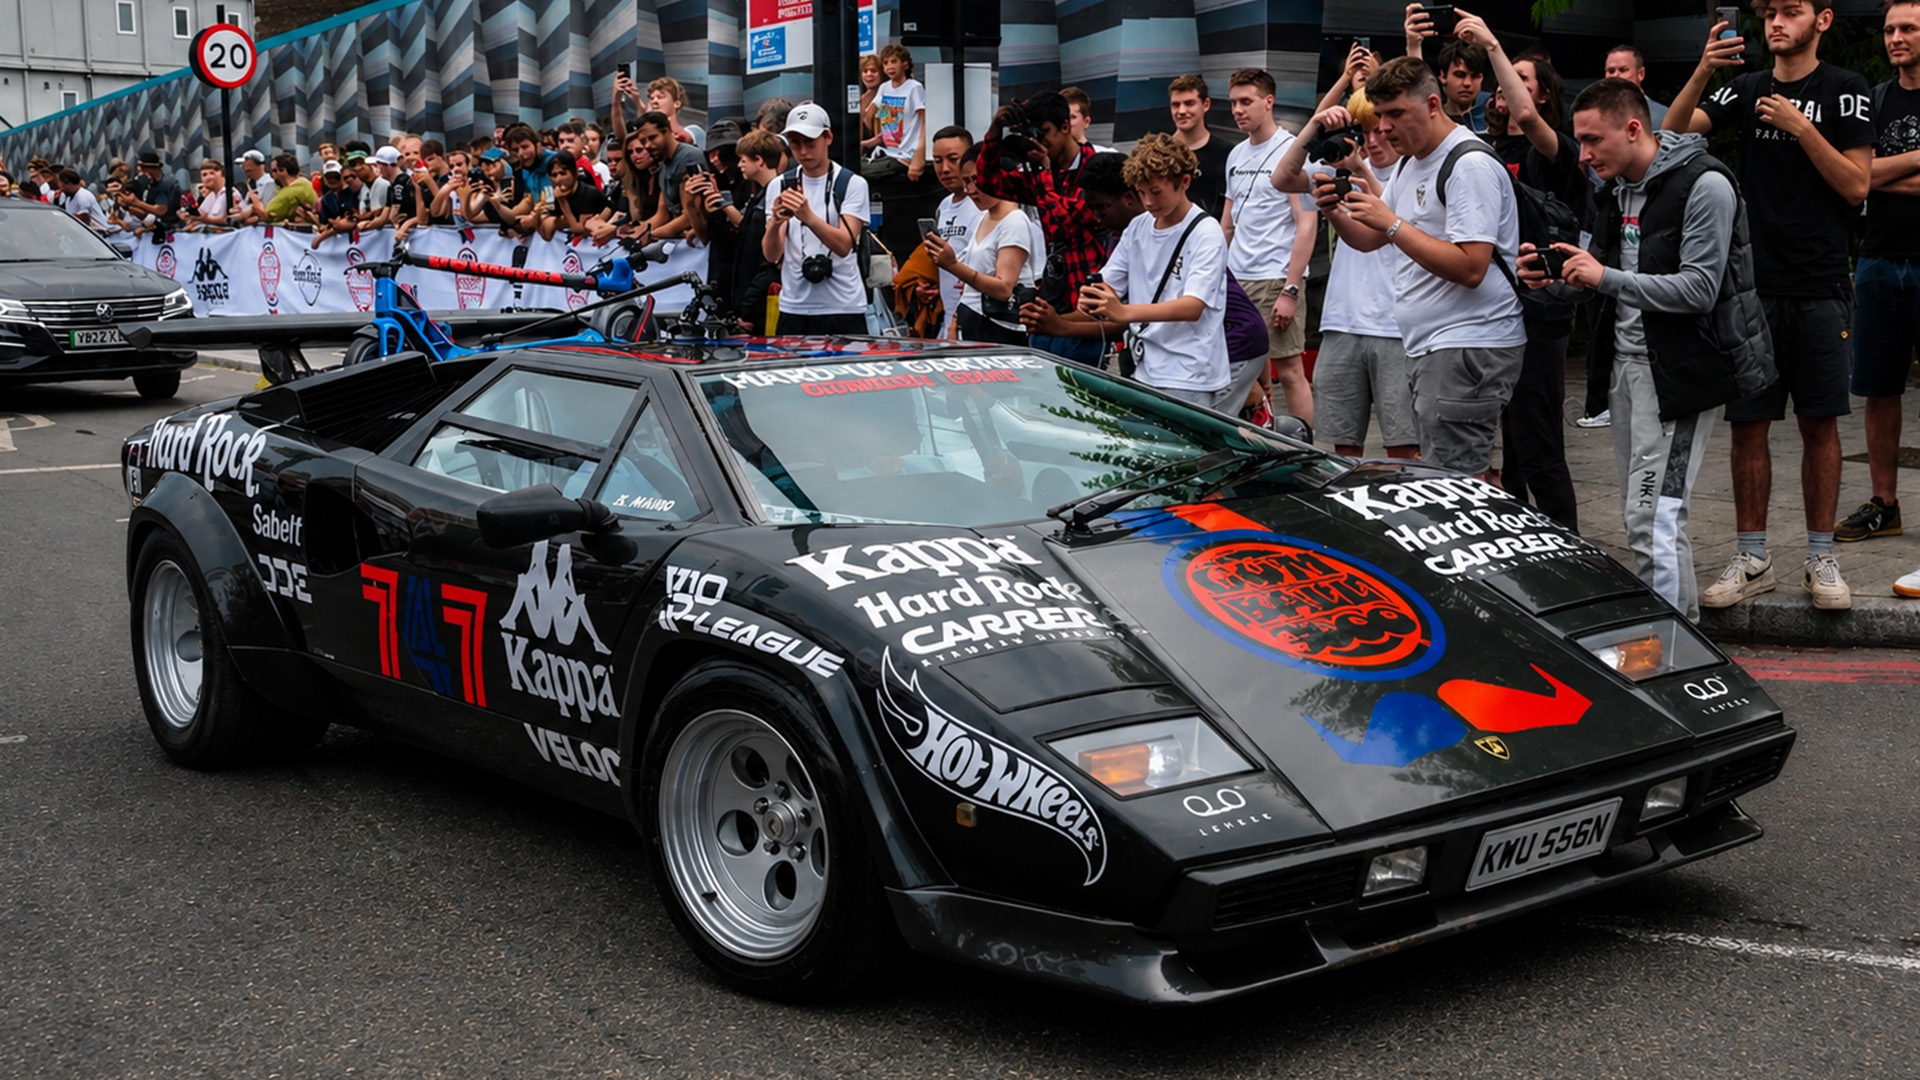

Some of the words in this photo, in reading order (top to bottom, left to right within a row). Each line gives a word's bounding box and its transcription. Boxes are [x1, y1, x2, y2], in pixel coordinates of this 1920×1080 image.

[209, 42, 248, 69] 20
[1839, 93, 1871, 122] DE
[195, 413, 268, 498] Rock
[1324, 477, 1516, 521] Kappa
[252, 503, 303, 547] Sabelt
[1385, 511, 1484, 552] Hard
[784, 536, 1042, 591] Kappa
[854, 578, 985, 629] Hard
[976, 575, 1094, 607] Rock
[500, 631, 621, 724] Kappa
[1537, 811, 1611, 860] 556N
